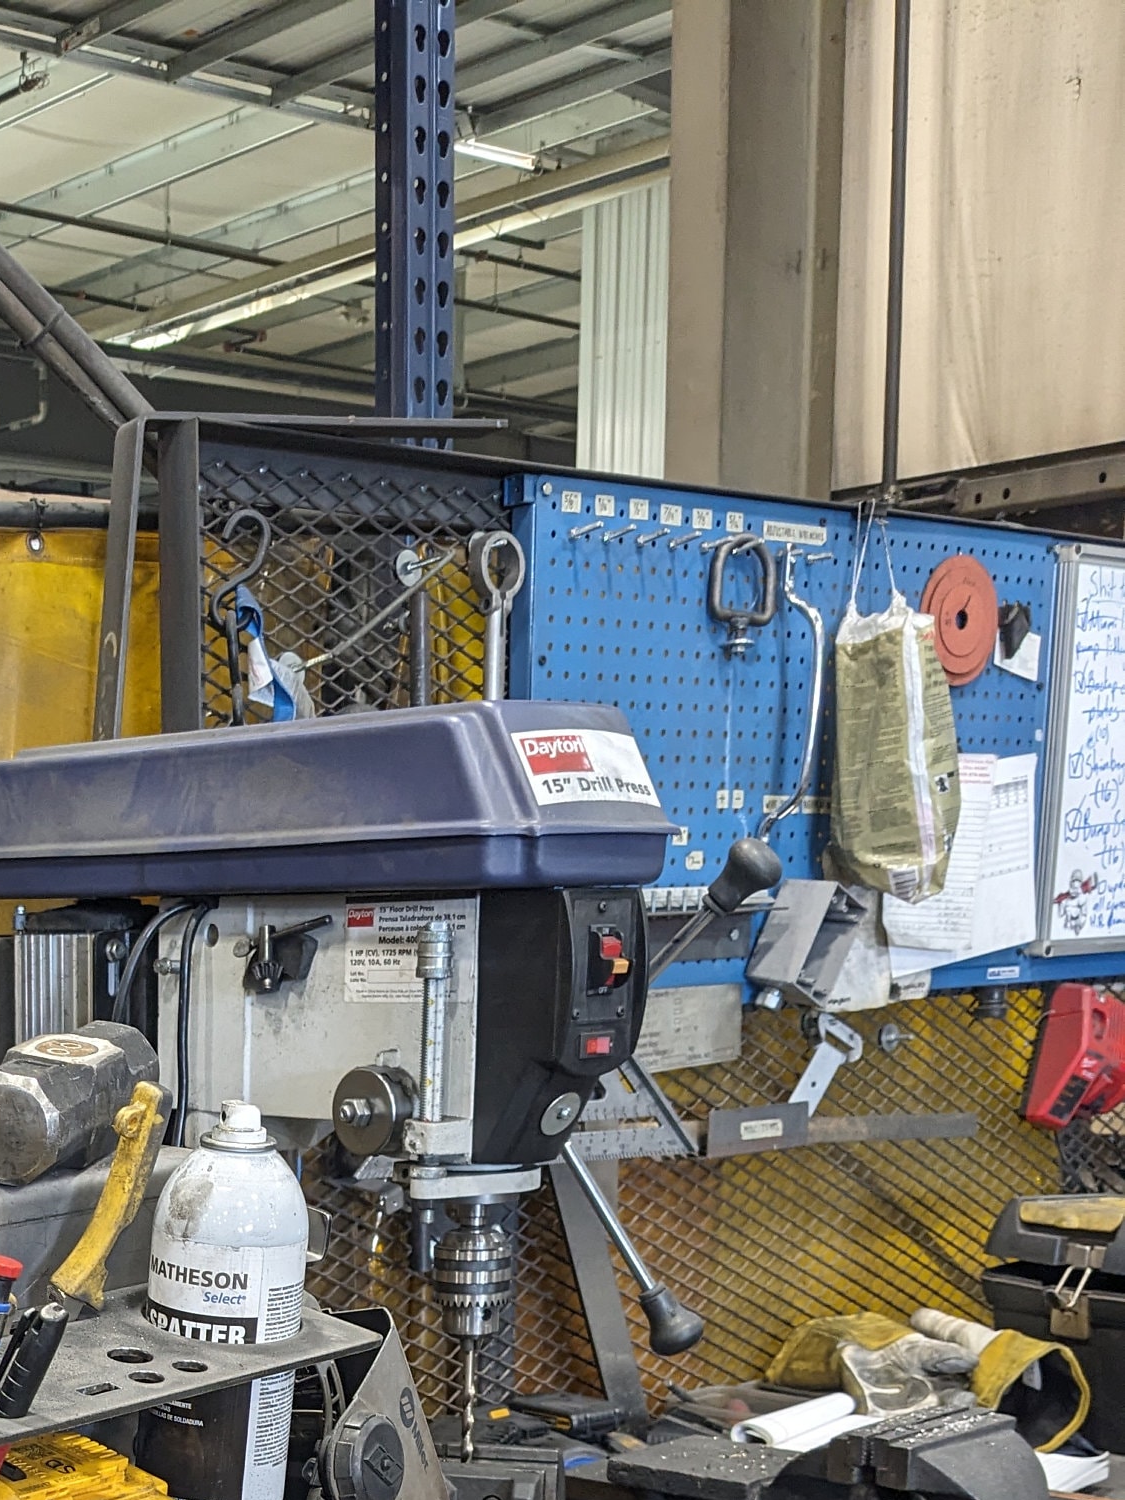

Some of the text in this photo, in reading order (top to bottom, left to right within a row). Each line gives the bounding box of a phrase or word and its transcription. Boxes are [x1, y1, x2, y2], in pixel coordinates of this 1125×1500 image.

[524, 737, 585, 759] Dayton
[542, 776, 652, 796] 15" Drill Press
[406, 904, 419, 912] Drill
[420, 904, 435, 912] Press
[348, 909, 373, 920] Dayton
[400, 914, 433, 922] Taladradora
[378, 936, 404, 944] Model:
[150, 1254, 248, 1290] MATHESON
[149, 1308, 246, 1345] SPATTER
[174, 1415, 204, 1427] SOLDADURA
